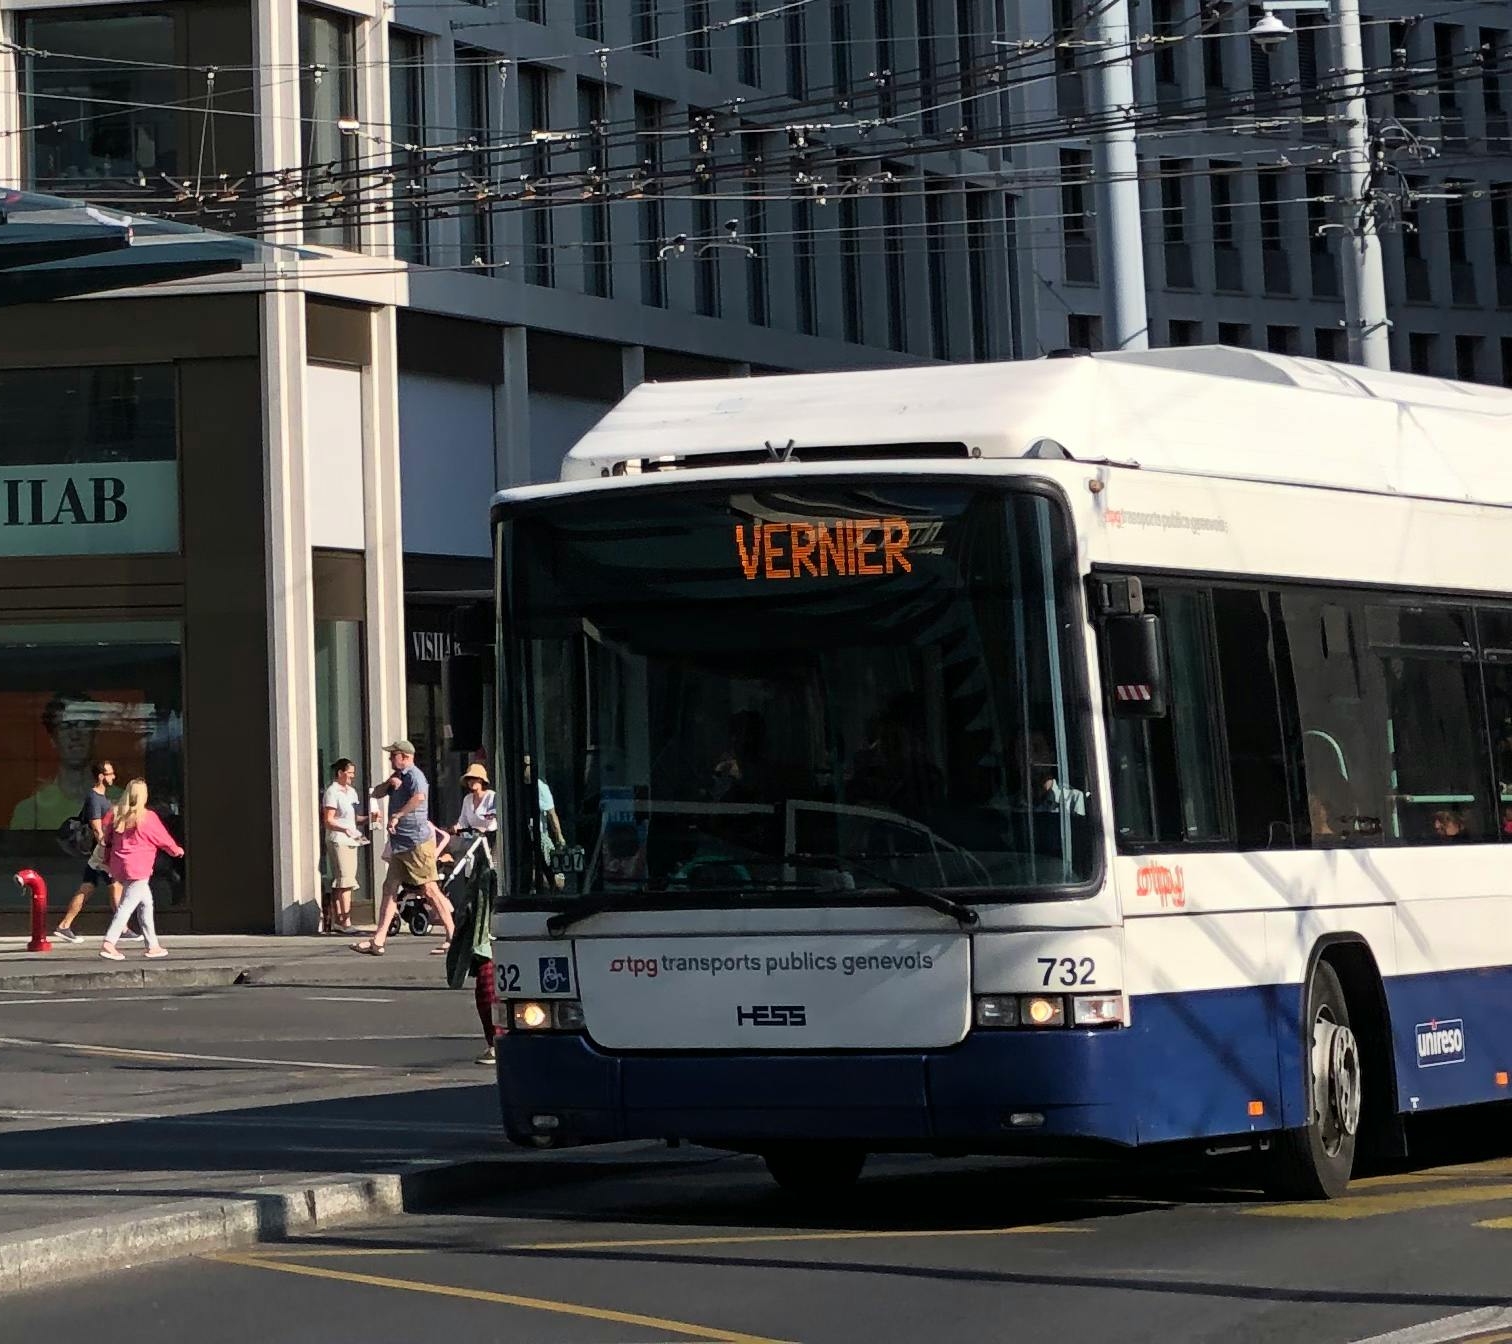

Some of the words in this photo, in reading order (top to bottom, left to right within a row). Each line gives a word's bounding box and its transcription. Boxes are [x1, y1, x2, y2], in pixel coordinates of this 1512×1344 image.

[735, 518, 913, 581] VERNIER
[662, 954, 762, 977] transports
[766, 951, 838, 976] publics
[842, 951, 934, 976] genevois
[1037, 957, 1096, 986] 732
[737, 1005, 807, 1026] HESS
[1417, 1024, 1463, 1057] unireso
